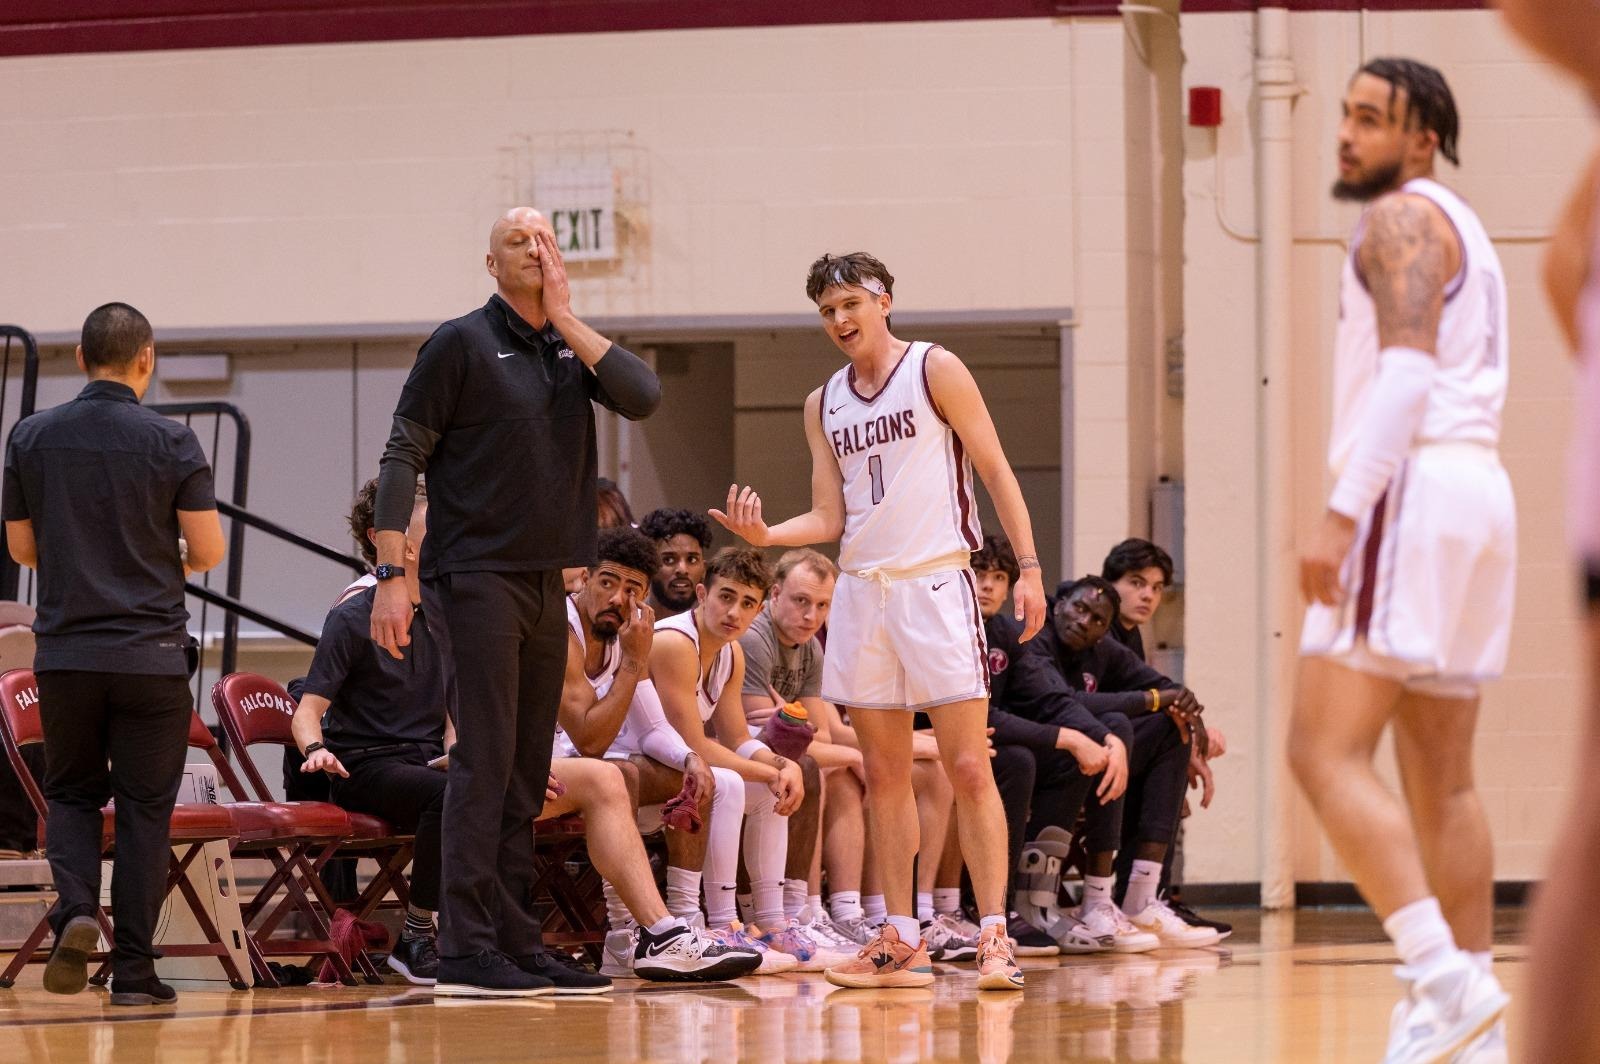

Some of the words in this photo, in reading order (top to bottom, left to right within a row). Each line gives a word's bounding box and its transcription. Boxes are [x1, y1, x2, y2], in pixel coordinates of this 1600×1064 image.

[551, 208, 602, 251] EXIT
[831, 409, 917, 459] FALCONS
[868, 454, 885, 506] 1
[15, 686, 39, 711] FAL
[240, 691, 293, 716] FALCONS
